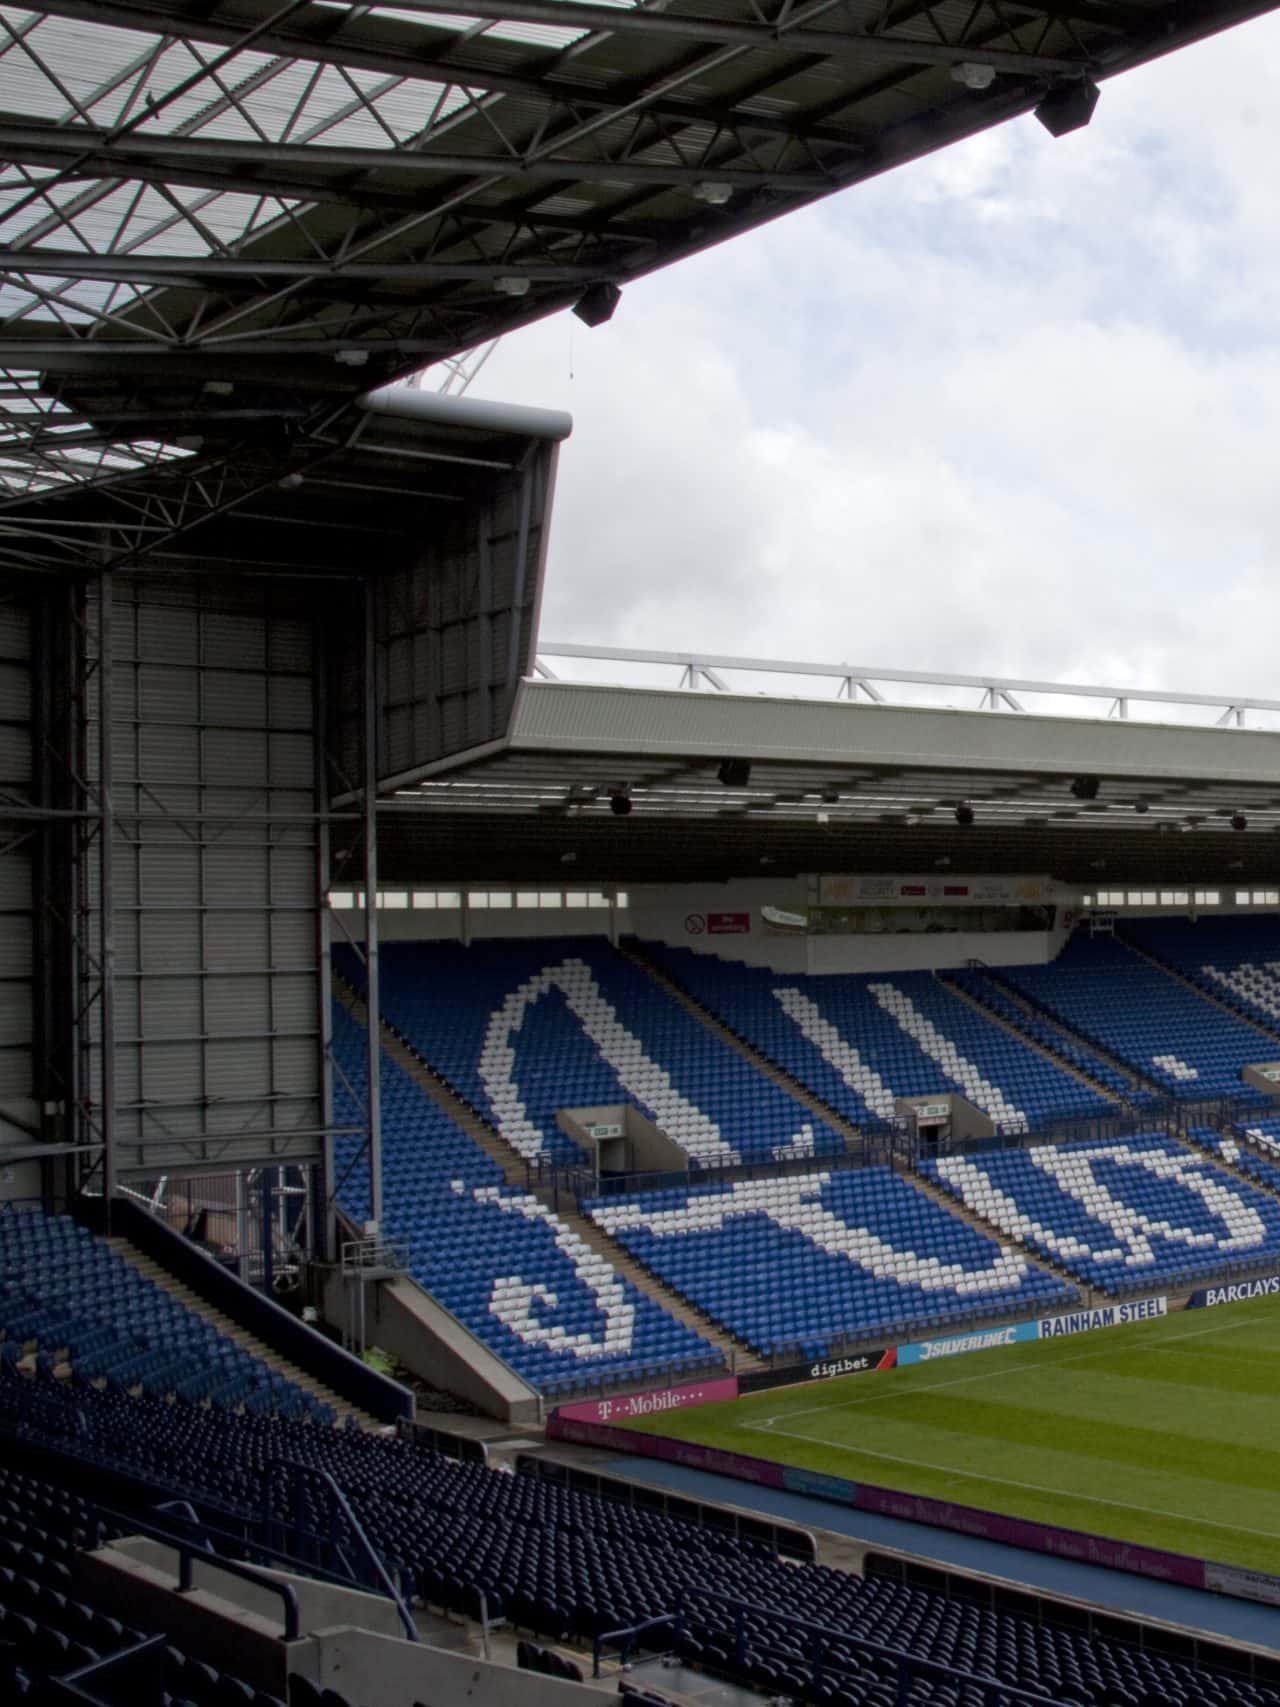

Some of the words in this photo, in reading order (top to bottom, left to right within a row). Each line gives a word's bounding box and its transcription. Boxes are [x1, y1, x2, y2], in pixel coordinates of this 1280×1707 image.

[1206, 1277, 1279, 1307] BARCLAYS
[1041, 1308, 1114, 1338] RAINHAM
[1119, 1297, 1164, 1323] STEEL
[928, 1331, 1010, 1359] SILVERLINE
[811, 1357, 868, 1378] digibet
